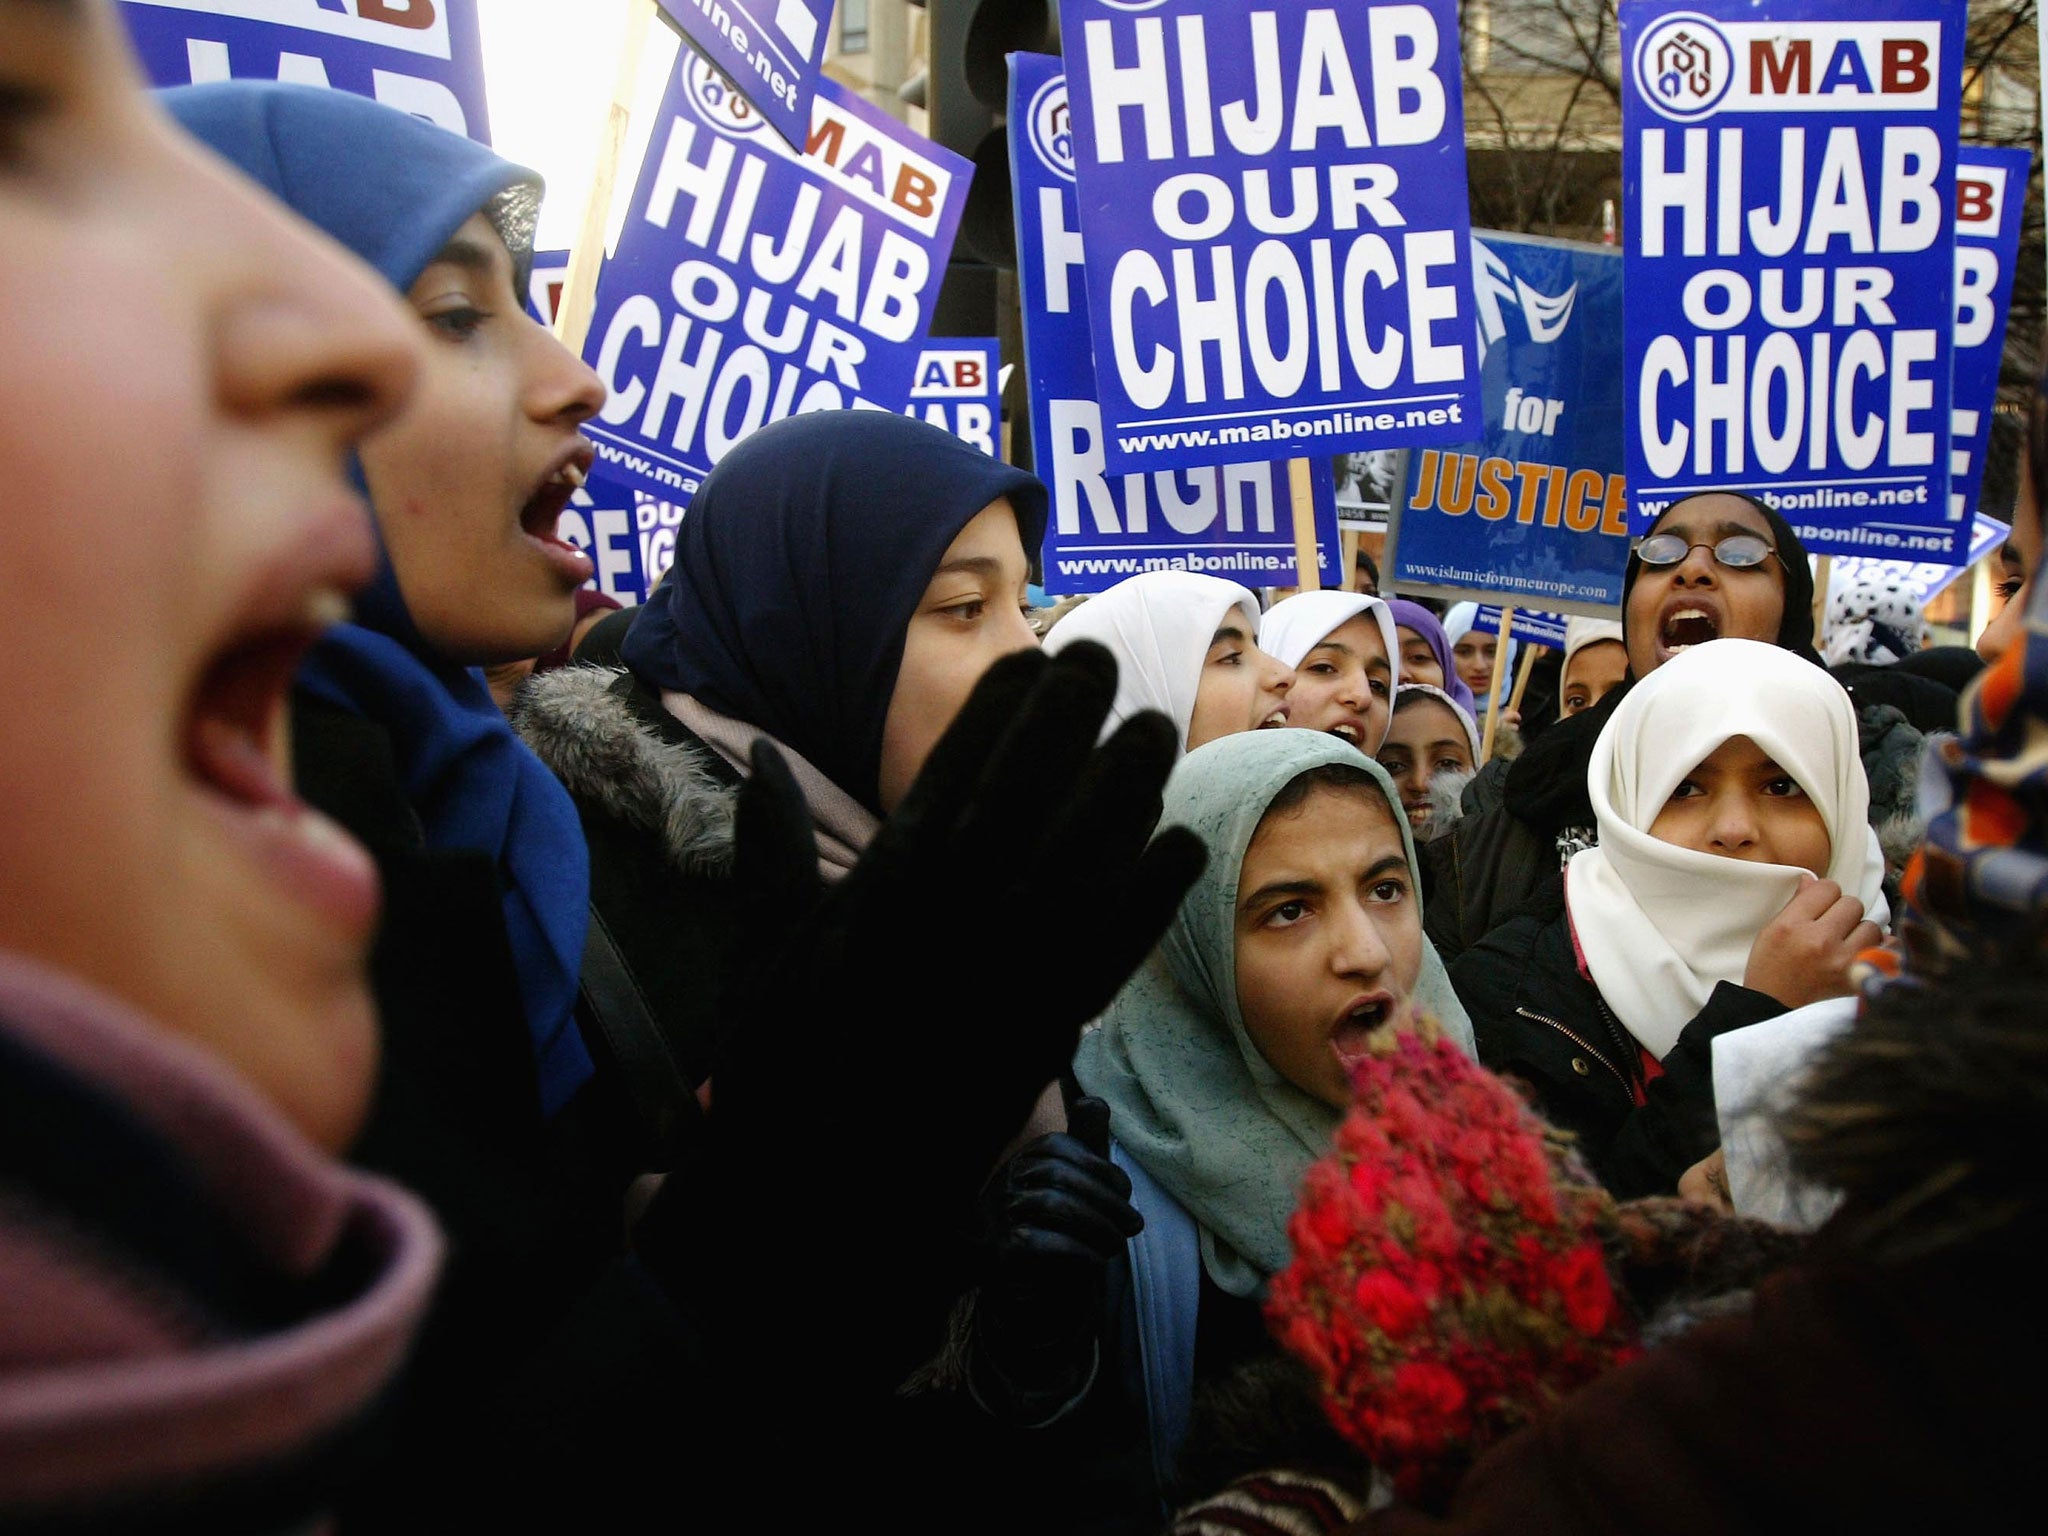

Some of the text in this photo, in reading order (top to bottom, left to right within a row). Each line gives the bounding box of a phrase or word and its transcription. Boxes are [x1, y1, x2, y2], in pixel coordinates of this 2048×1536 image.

[1084, 4, 1446, 164] HIJAB
[1749, 39, 1931, 95] MAB
[644, 115, 930, 343] HIJAB
[1152, 163, 1407, 241] OUR
[1641, 126, 1941, 257] HIJAB
[671, 260, 867, 390] OUR
[1110, 230, 1466, 410] CHOICE
[1682, 266, 1897, 330] OUR
[596, 294, 892, 467] CHO
[913, 360, 982, 388] AB
[1503, 387, 1565, 436] for
[1639, 329, 1937, 479] CHOICE
[1049, 399, 1276, 535] RGH
[1118, 403, 1463, 454] www.mabonline.net
[1409, 449, 1628, 536] JUSTICE
[1057, 552, 1328, 576] www.mabonline.nt
[1405, 562, 1608, 599] www.islamicforumeurope.com
